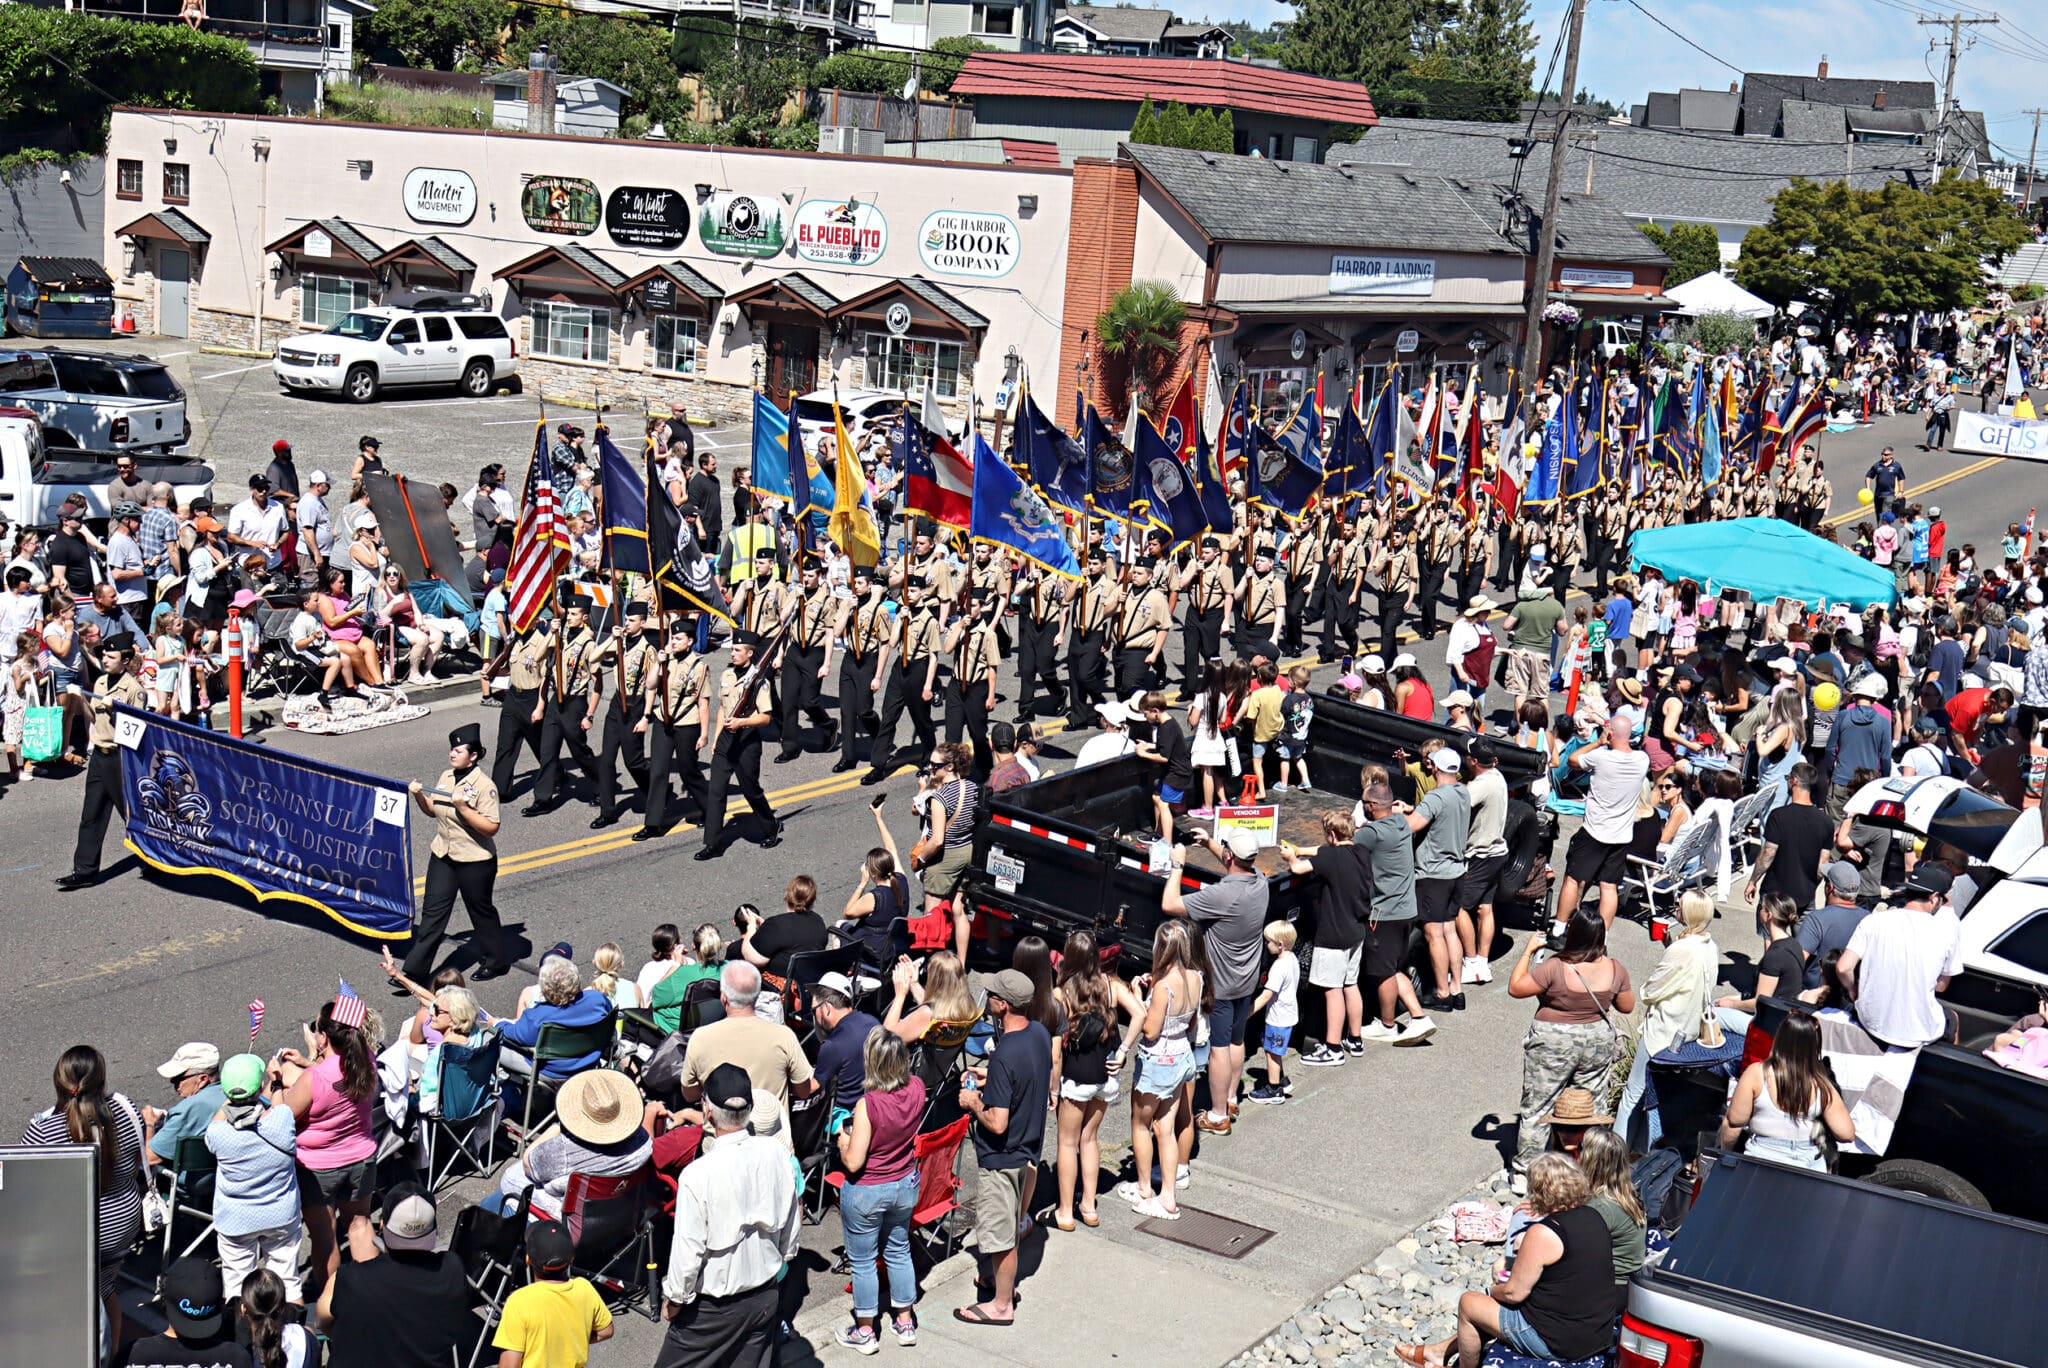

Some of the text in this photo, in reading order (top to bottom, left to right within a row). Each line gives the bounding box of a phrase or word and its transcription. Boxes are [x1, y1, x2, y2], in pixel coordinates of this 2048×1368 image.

[417, 201, 463, 213] MOVEMENT
[729, 198, 758, 215] FOX ISLAND
[527, 218, 552, 227] VINTAGE
[560, 221, 595, 231] ADVENTURE
[622, 212, 666, 222] CANDLE CO.
[937, 217, 1006, 234] GIG HARBOR
[727, 222, 750, 239] TRADING
[799, 224, 881, 248] EL PUEBLITO
[945, 232, 1010, 255] BOOK
[810, 249, 867, 260] 253-858-9077
[934, 254, 1003, 271] COMPANY
[1336, 259, 1432, 279] HARBOR LANDING
[122, 720, 141, 738] 37
[240, 775, 376, 837] PENINSULA
[380, 795, 399, 814] 37
[220, 799, 397, 871] SCHOOL DISTRICT
